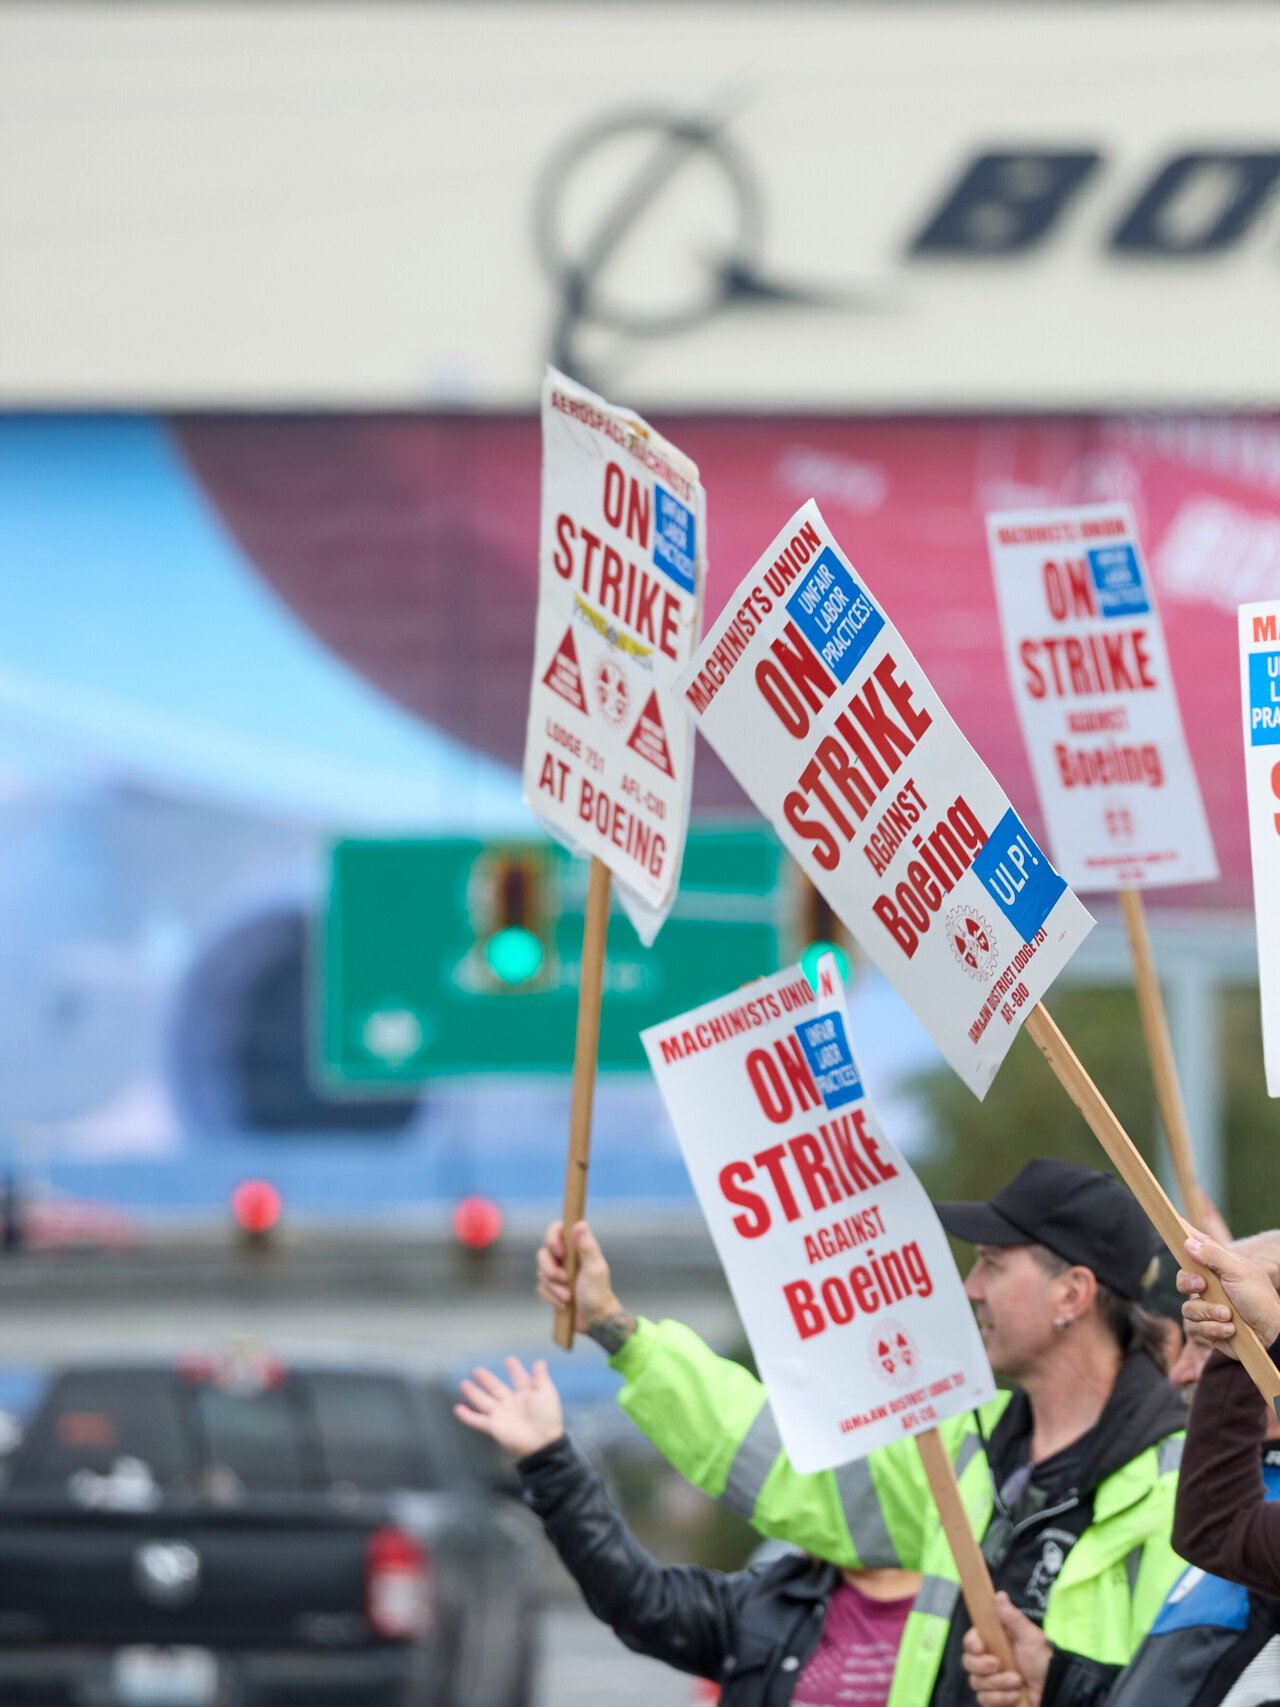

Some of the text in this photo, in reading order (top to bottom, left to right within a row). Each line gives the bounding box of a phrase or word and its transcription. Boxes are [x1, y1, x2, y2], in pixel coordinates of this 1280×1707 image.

[603, 461, 650, 549] ON
[553, 514, 681, 661] STRIKE
[685, 521, 822, 715] MACHINISTS UNION
[798, 563, 835, 615] UNFAIR
[815, 586, 849, 634] LABOR
[1041, 558, 1097, 622] ON
[821, 594, 873, 669] PRACTICES!
[1018, 629, 1157, 702] STRIKE
[755, 620, 837, 739] ON
[546, 716, 581, 759] LODGE
[783, 653, 933, 871] STRIKE
[1053, 738, 1165, 789] Boeing
[539, 752, 666, 879] AT BOEING
[862, 777, 928, 878] AGAINST
[872, 795, 989, 960] Boeing
[989, 834, 1040, 906] ULP!
[659, 993, 781, 1064] MACHINISTS
[987, 967, 1017, 1012] DISTRICT
[744, 1032, 823, 1124] ON
[718, 1109, 899, 1240] STRIKE
[803, 1205, 886, 1265] AGAINST
[782, 1239, 934, 1341] Boeing
